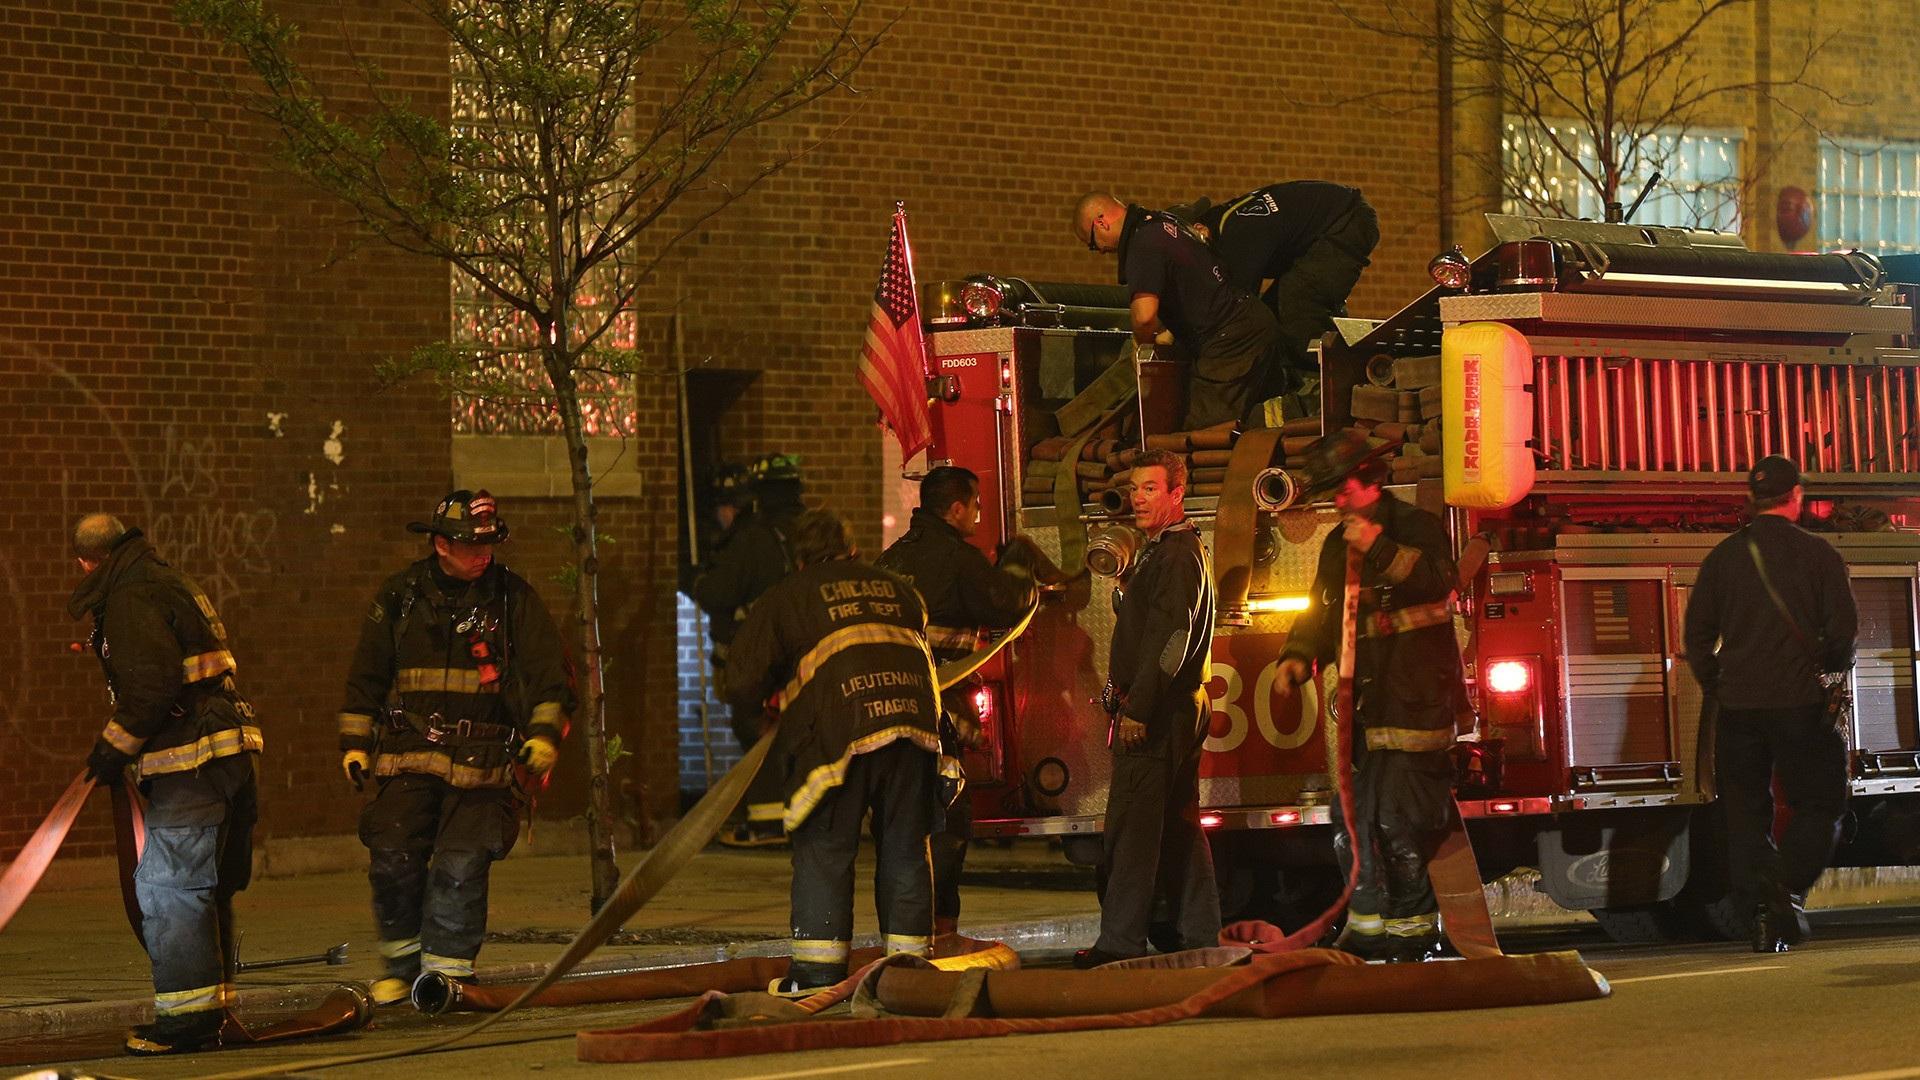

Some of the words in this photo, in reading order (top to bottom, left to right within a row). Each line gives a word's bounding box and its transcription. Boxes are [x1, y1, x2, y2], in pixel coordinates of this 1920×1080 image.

[942, 358, 977, 368] FDD603
[1464, 360, 1480, 412] KEEP
[1464, 416, 1480, 469] BACK
[819, 580, 896, 602] CHICAGO
[828, 602, 863, 622] FIRE
[869, 602, 902, 618] DEPT
[841, 671, 924, 698] LIEUTENANT
[864, 699, 919, 719] TRAGOS
[1202, 658, 1319, 753] 30
